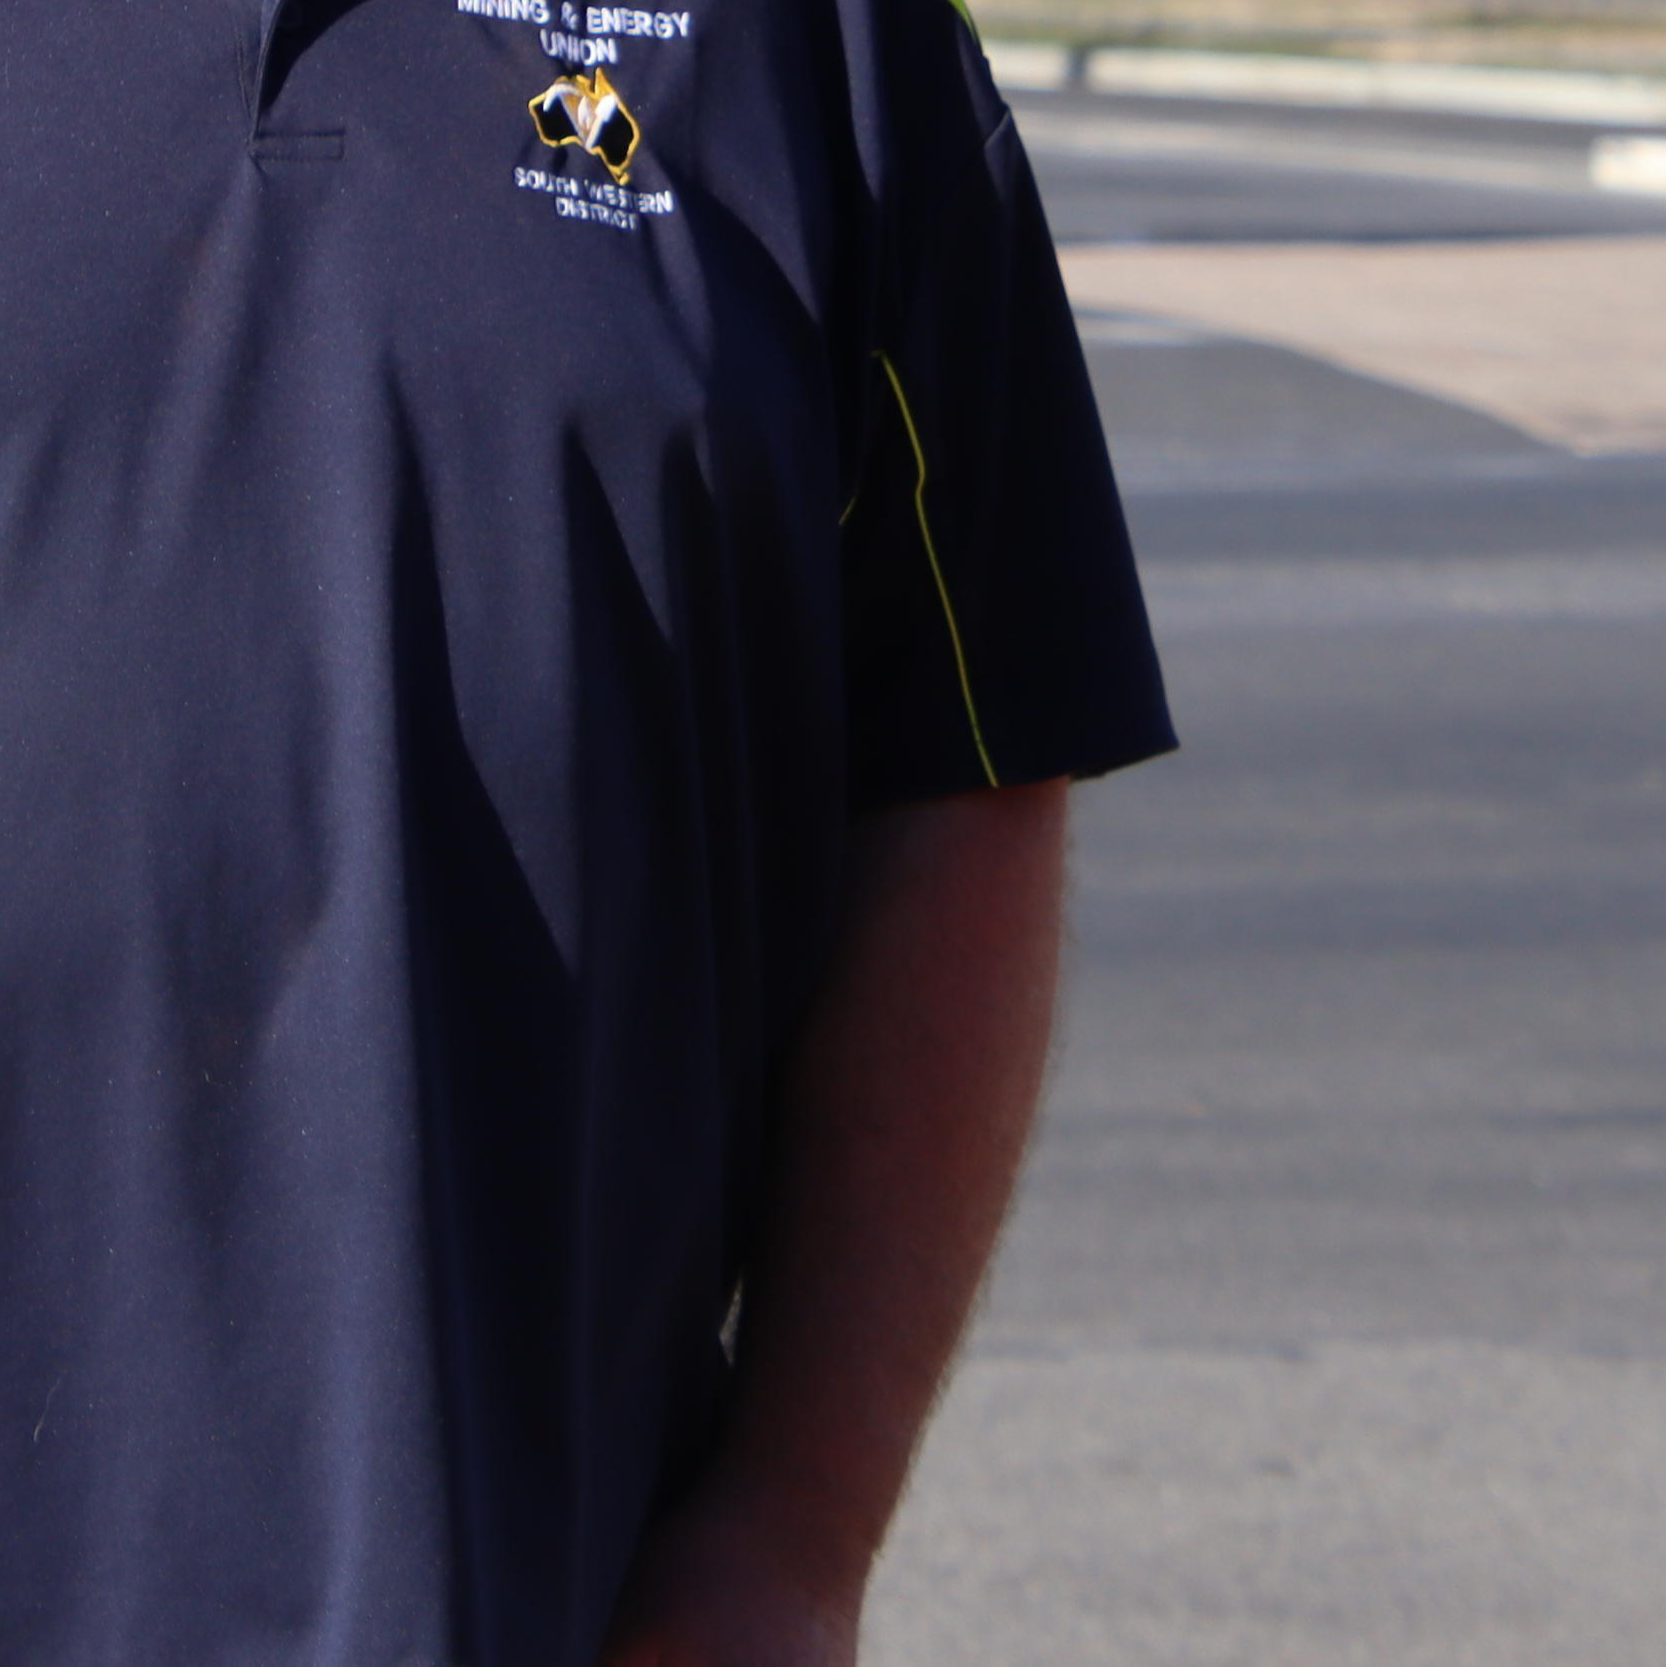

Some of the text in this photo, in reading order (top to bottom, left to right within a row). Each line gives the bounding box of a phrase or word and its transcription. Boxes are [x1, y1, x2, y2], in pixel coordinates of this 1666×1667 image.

[562, 2, 579, 30] &
[586, 6, 691, 39] ENERGY
[540, 28, 618, 66] UNION
[514, 166, 579, 196] SOUTH
[555, 196, 638, 230] DISTRICT
